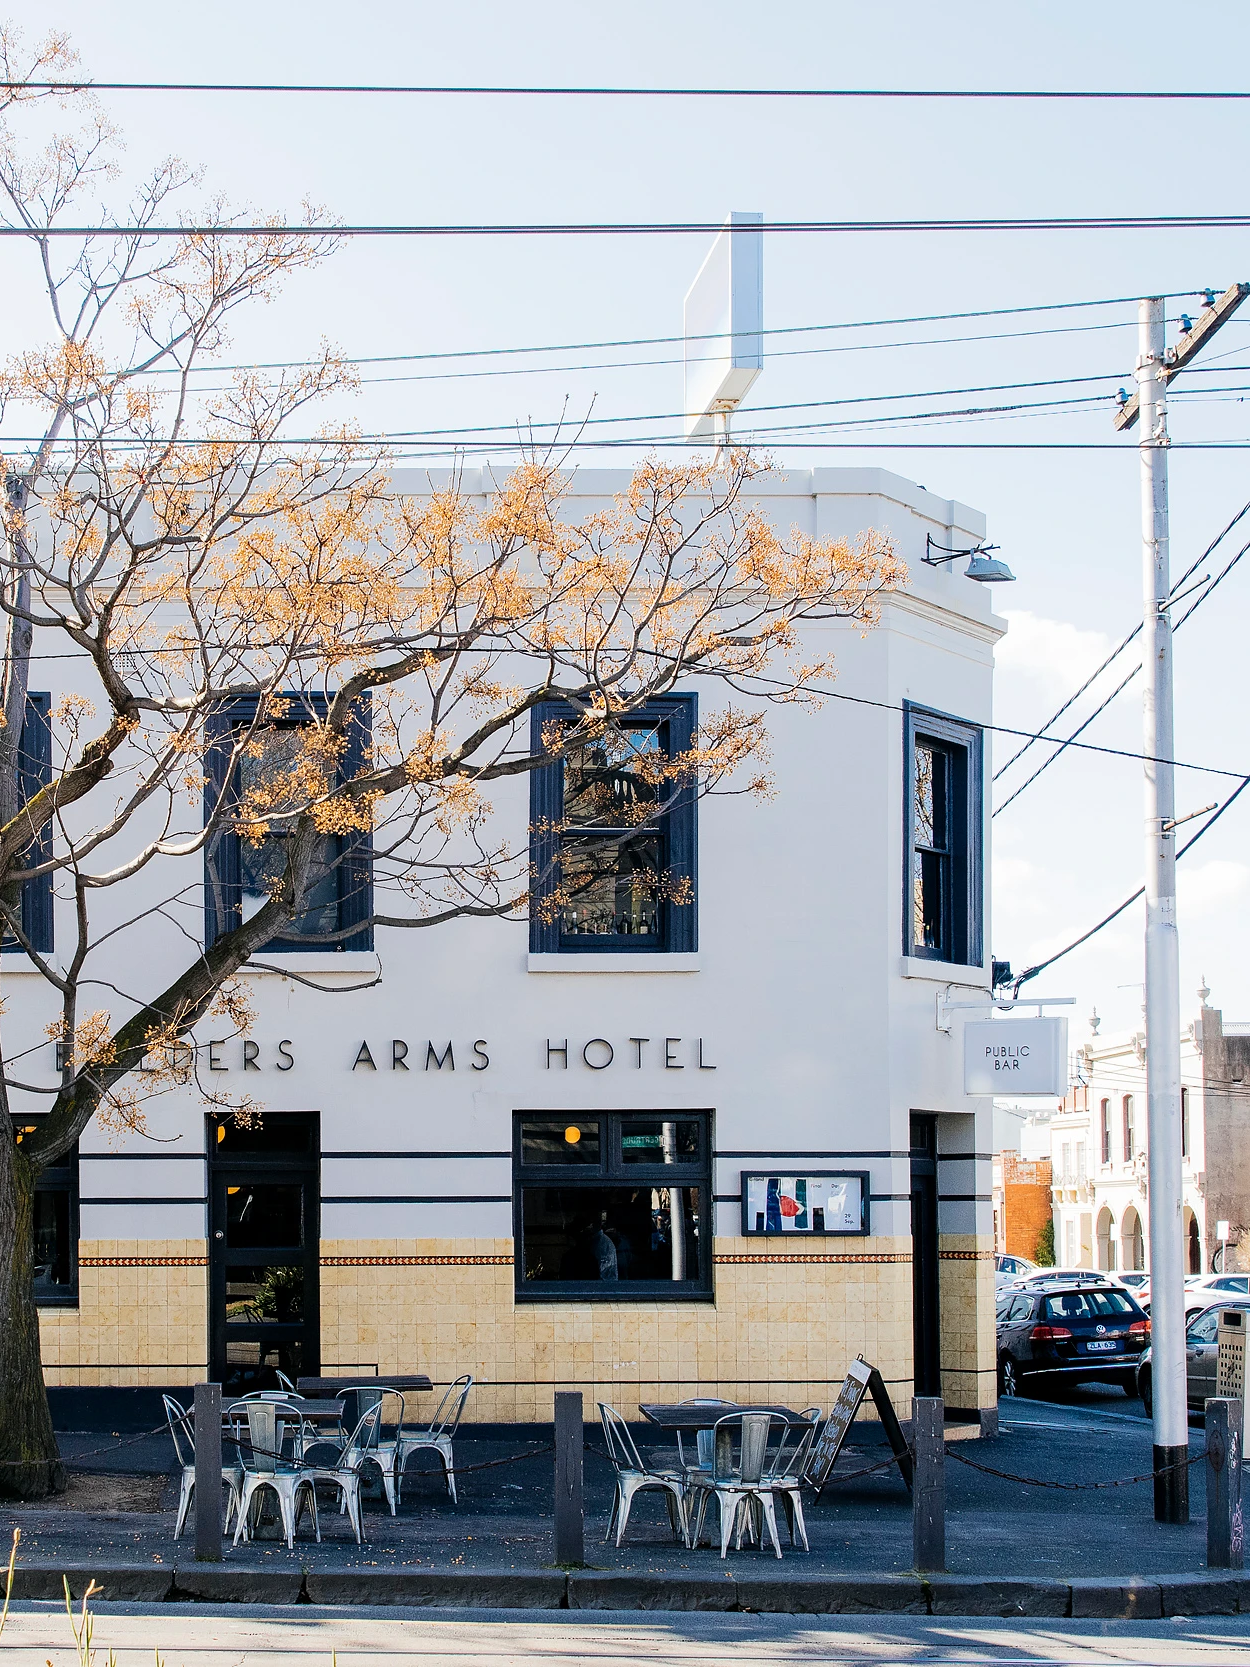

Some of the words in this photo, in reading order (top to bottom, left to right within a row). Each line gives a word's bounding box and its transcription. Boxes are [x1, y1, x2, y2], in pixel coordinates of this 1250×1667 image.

[56, 1040, 294, 1072] DERS
[352, 1039, 490, 1071] ARMS
[546, 1037, 717, 1070] HOTEL
[985, 1046, 1030, 1057] PUBLIC
[994, 1060, 1020, 1070] BAR
